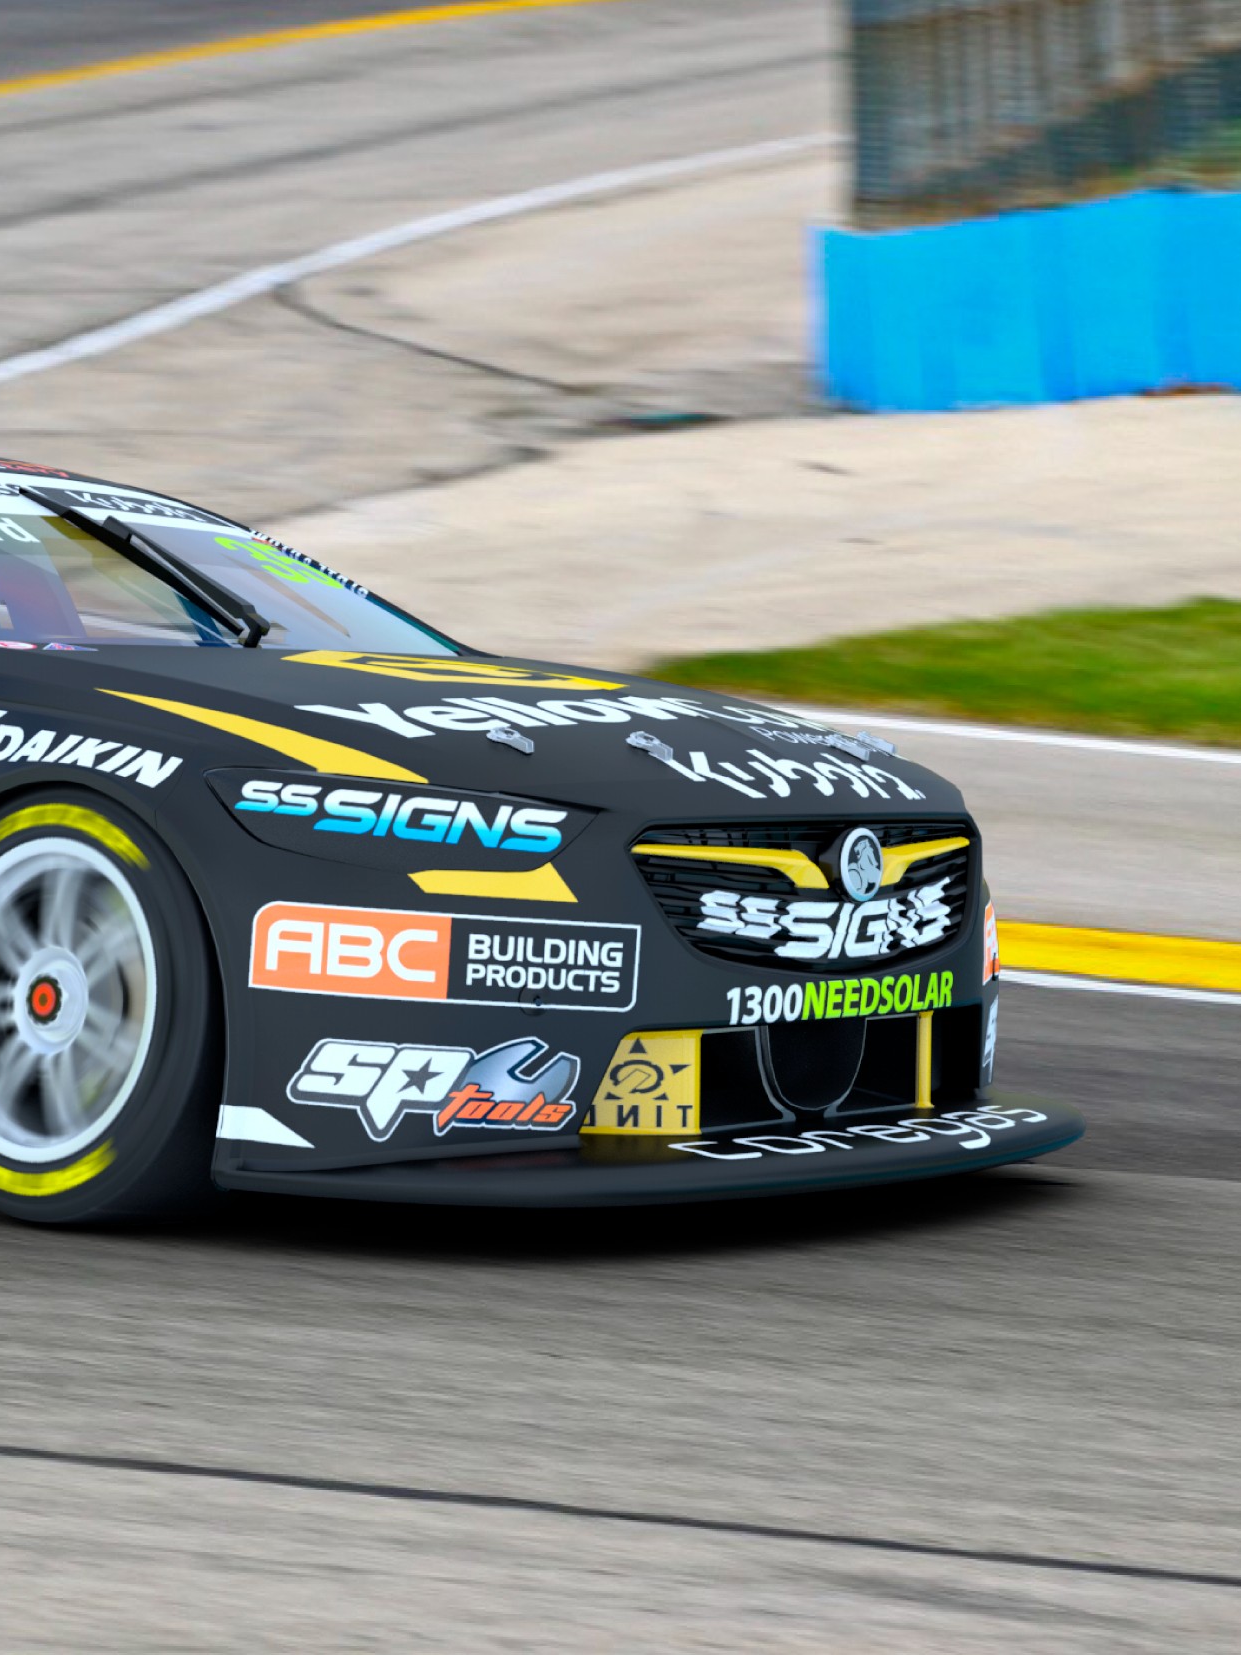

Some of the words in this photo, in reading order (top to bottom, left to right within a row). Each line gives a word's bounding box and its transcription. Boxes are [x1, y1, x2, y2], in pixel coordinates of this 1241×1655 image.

[313, 788, 568, 853] SIGNS
[266, 919, 438, 983] ABC
[467, 933, 624, 968] BUILDING
[465, 964, 620, 993] PRODUCTS
[437, 1084, 575, 1129] tools
